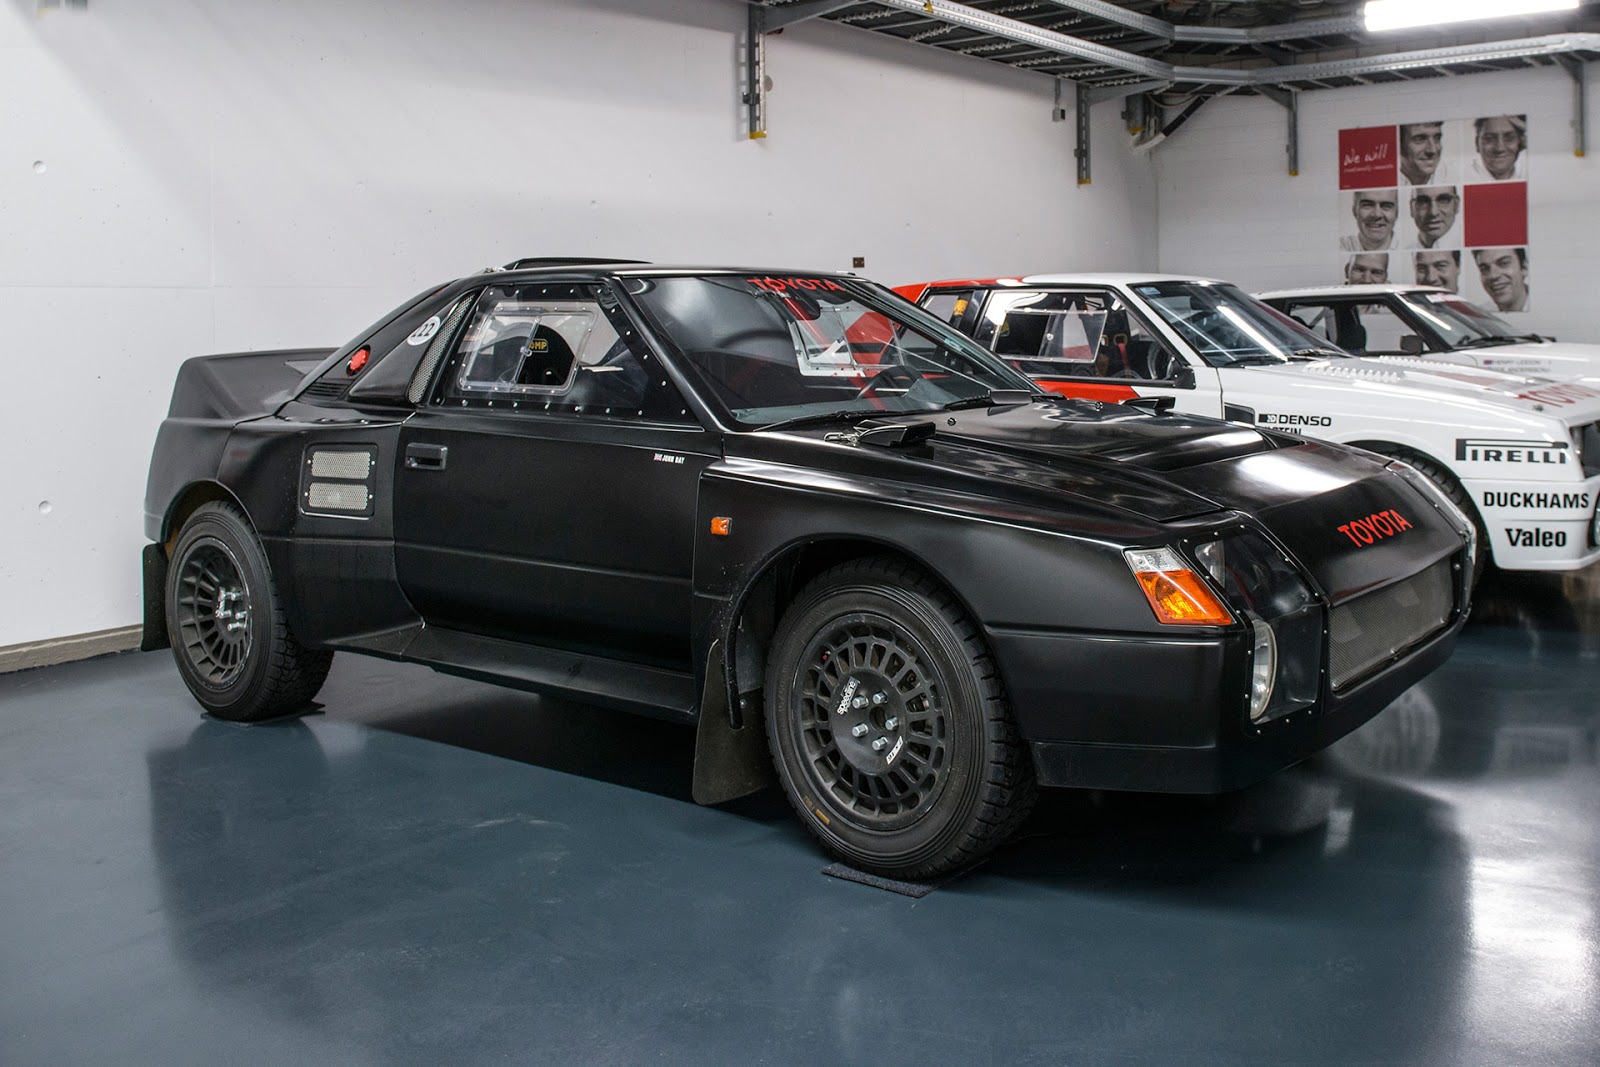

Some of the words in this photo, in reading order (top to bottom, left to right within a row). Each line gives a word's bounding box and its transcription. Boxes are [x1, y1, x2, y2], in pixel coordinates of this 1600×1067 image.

[1364, 143, 1388, 162] will
[747, 278, 847, 291] TOYOTA
[1279, 414, 1332, 427] DENSO
[1455, 438, 1569, 464] PIRELLI
[1483, 491, 1590, 509] DUCKHAMS
[1337, 509, 1413, 548] TOYOTA
[1504, 527, 1568, 548] Valeo
[836, 681, 857, 715] speedline
